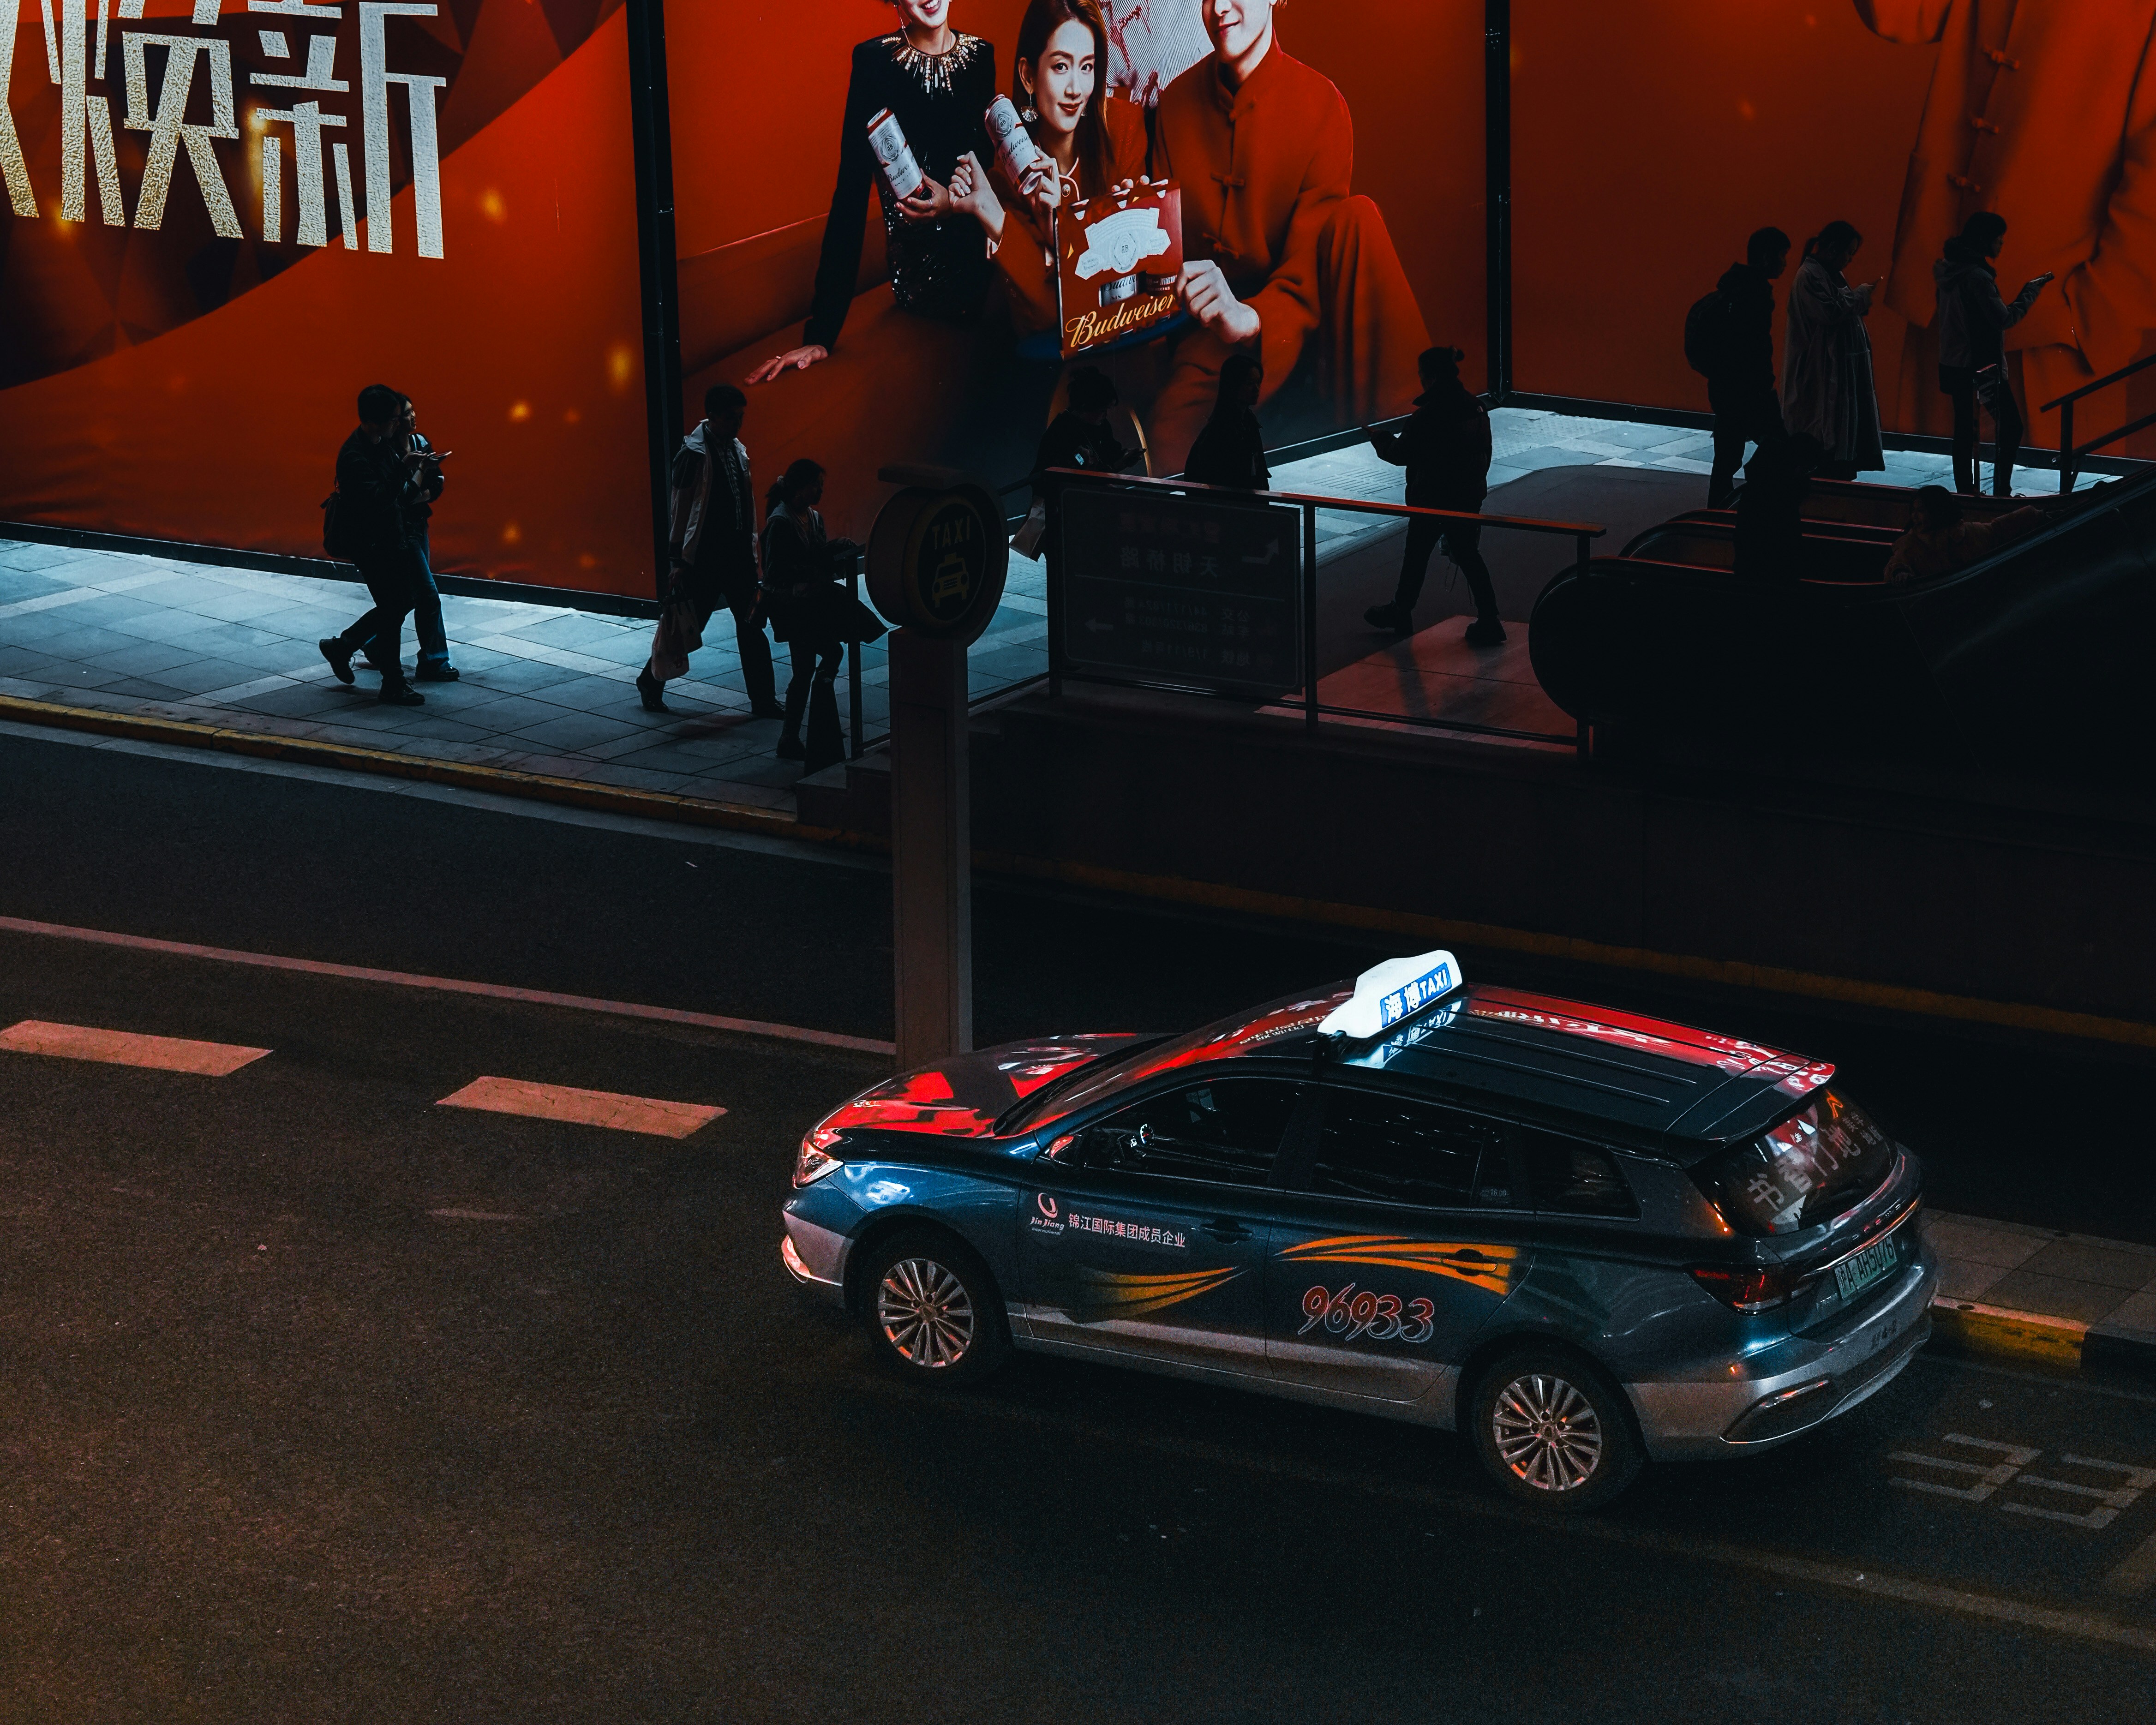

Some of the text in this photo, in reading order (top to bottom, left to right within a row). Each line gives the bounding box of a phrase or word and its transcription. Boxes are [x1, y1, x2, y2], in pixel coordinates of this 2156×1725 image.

[1065, 294, 1175, 347] Budweiser
[932, 515, 970, 550] TAXI
[1068, 1213, 1186, 1248] 锦江国际集团成员企业
[1298, 1283, 1435, 1343] 96933
